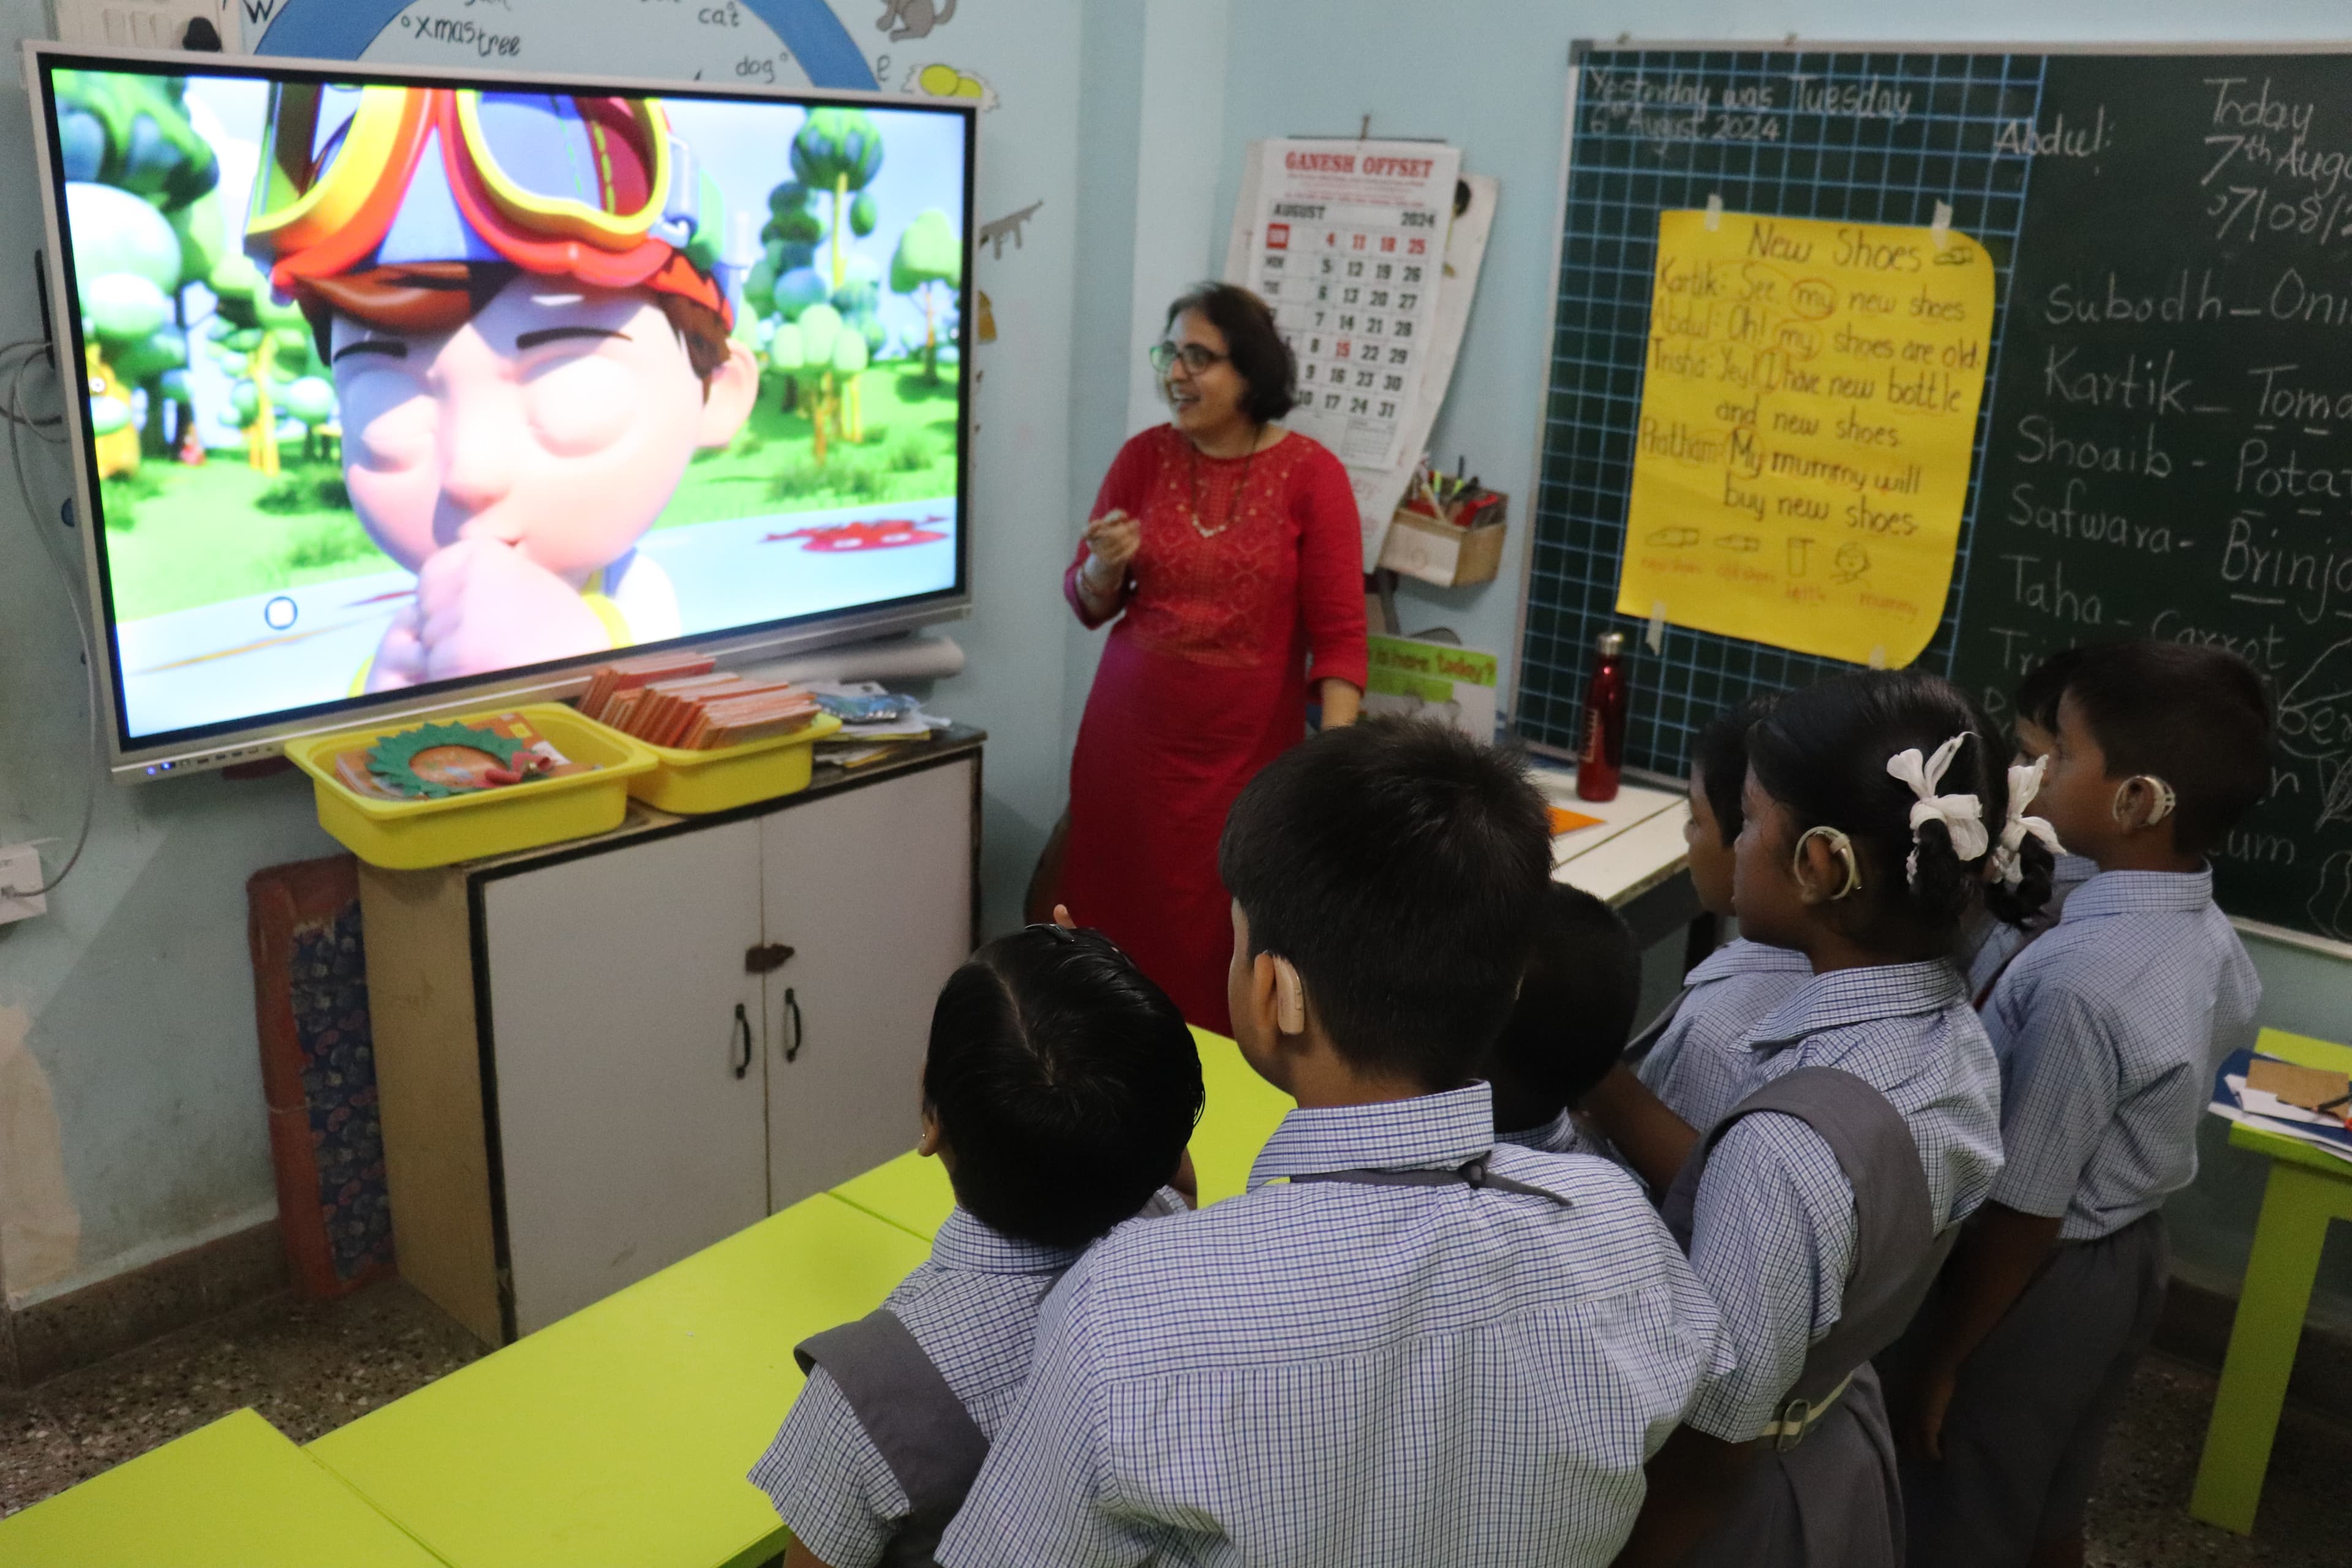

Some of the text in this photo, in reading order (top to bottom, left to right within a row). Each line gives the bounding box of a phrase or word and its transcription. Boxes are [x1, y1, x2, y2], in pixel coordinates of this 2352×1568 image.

[697, 7, 741, 27] cat
[735, 55, 774, 83] dog
[1785, 73, 1912, 124] Tuesday
[2204, 77, 2314, 146] Today
[1713, 114, 1780, 141] 2024
[1285, 151, 1355, 173] GANESH
[1362, 156, 1434, 178] OFFSET
[1274, 204, 1436, 227] AUGUST 2024
[1327, 232, 1426, 255] 4 11 18 25
[1749, 222, 1923, 273] New Shoes
[1323, 257, 1332, 274] 5
[1348, 261, 1363, 277] 12
[1376, 263, 1392, 280] 19
[1404, 265, 1421, 282] 26
[1343, 287, 1359, 304] 13
[1369, 290, 1388, 307] 20
[1399, 293, 1418, 309] 27
[1849, 290, 1896, 314] new
[1910, 283, 1965, 322] shoes
[2045, 268, 2222, 324] Subodh
[2270, 268, 2351, 325] Oni
[1316, 312, 1412, 337] 7 14 21 28
[1834, 321, 1894, 360] shoes
[1902, 340, 1934, 365] are
[1336, 341, 1351, 358] 15
[1361, 344, 1379, 361] 22
[1389, 347, 1408, 364] 29
[1306, 364, 1403, 391] 9 16 23 30
[1828, 376, 1874, 399] new
[1887, 366, 1962, 412] bottle
[2045, 345, 2192, 415] Kartik
[1325, 394, 1341, 409] 17
[1350, 398, 1368, 414] 24
[1378, 401, 1395, 418] 31
[1715, 393, 1760, 426] and
[1773, 412, 1820, 436] new
[1730, 427, 1766, 479] My
[1874, 466, 1921, 495] will
[2018, 415, 2172, 478] Shoaib
[1724, 470, 1765, 522] buy
[1777, 495, 1829, 521] new
[2000, 555, 2101, 625] Taha
